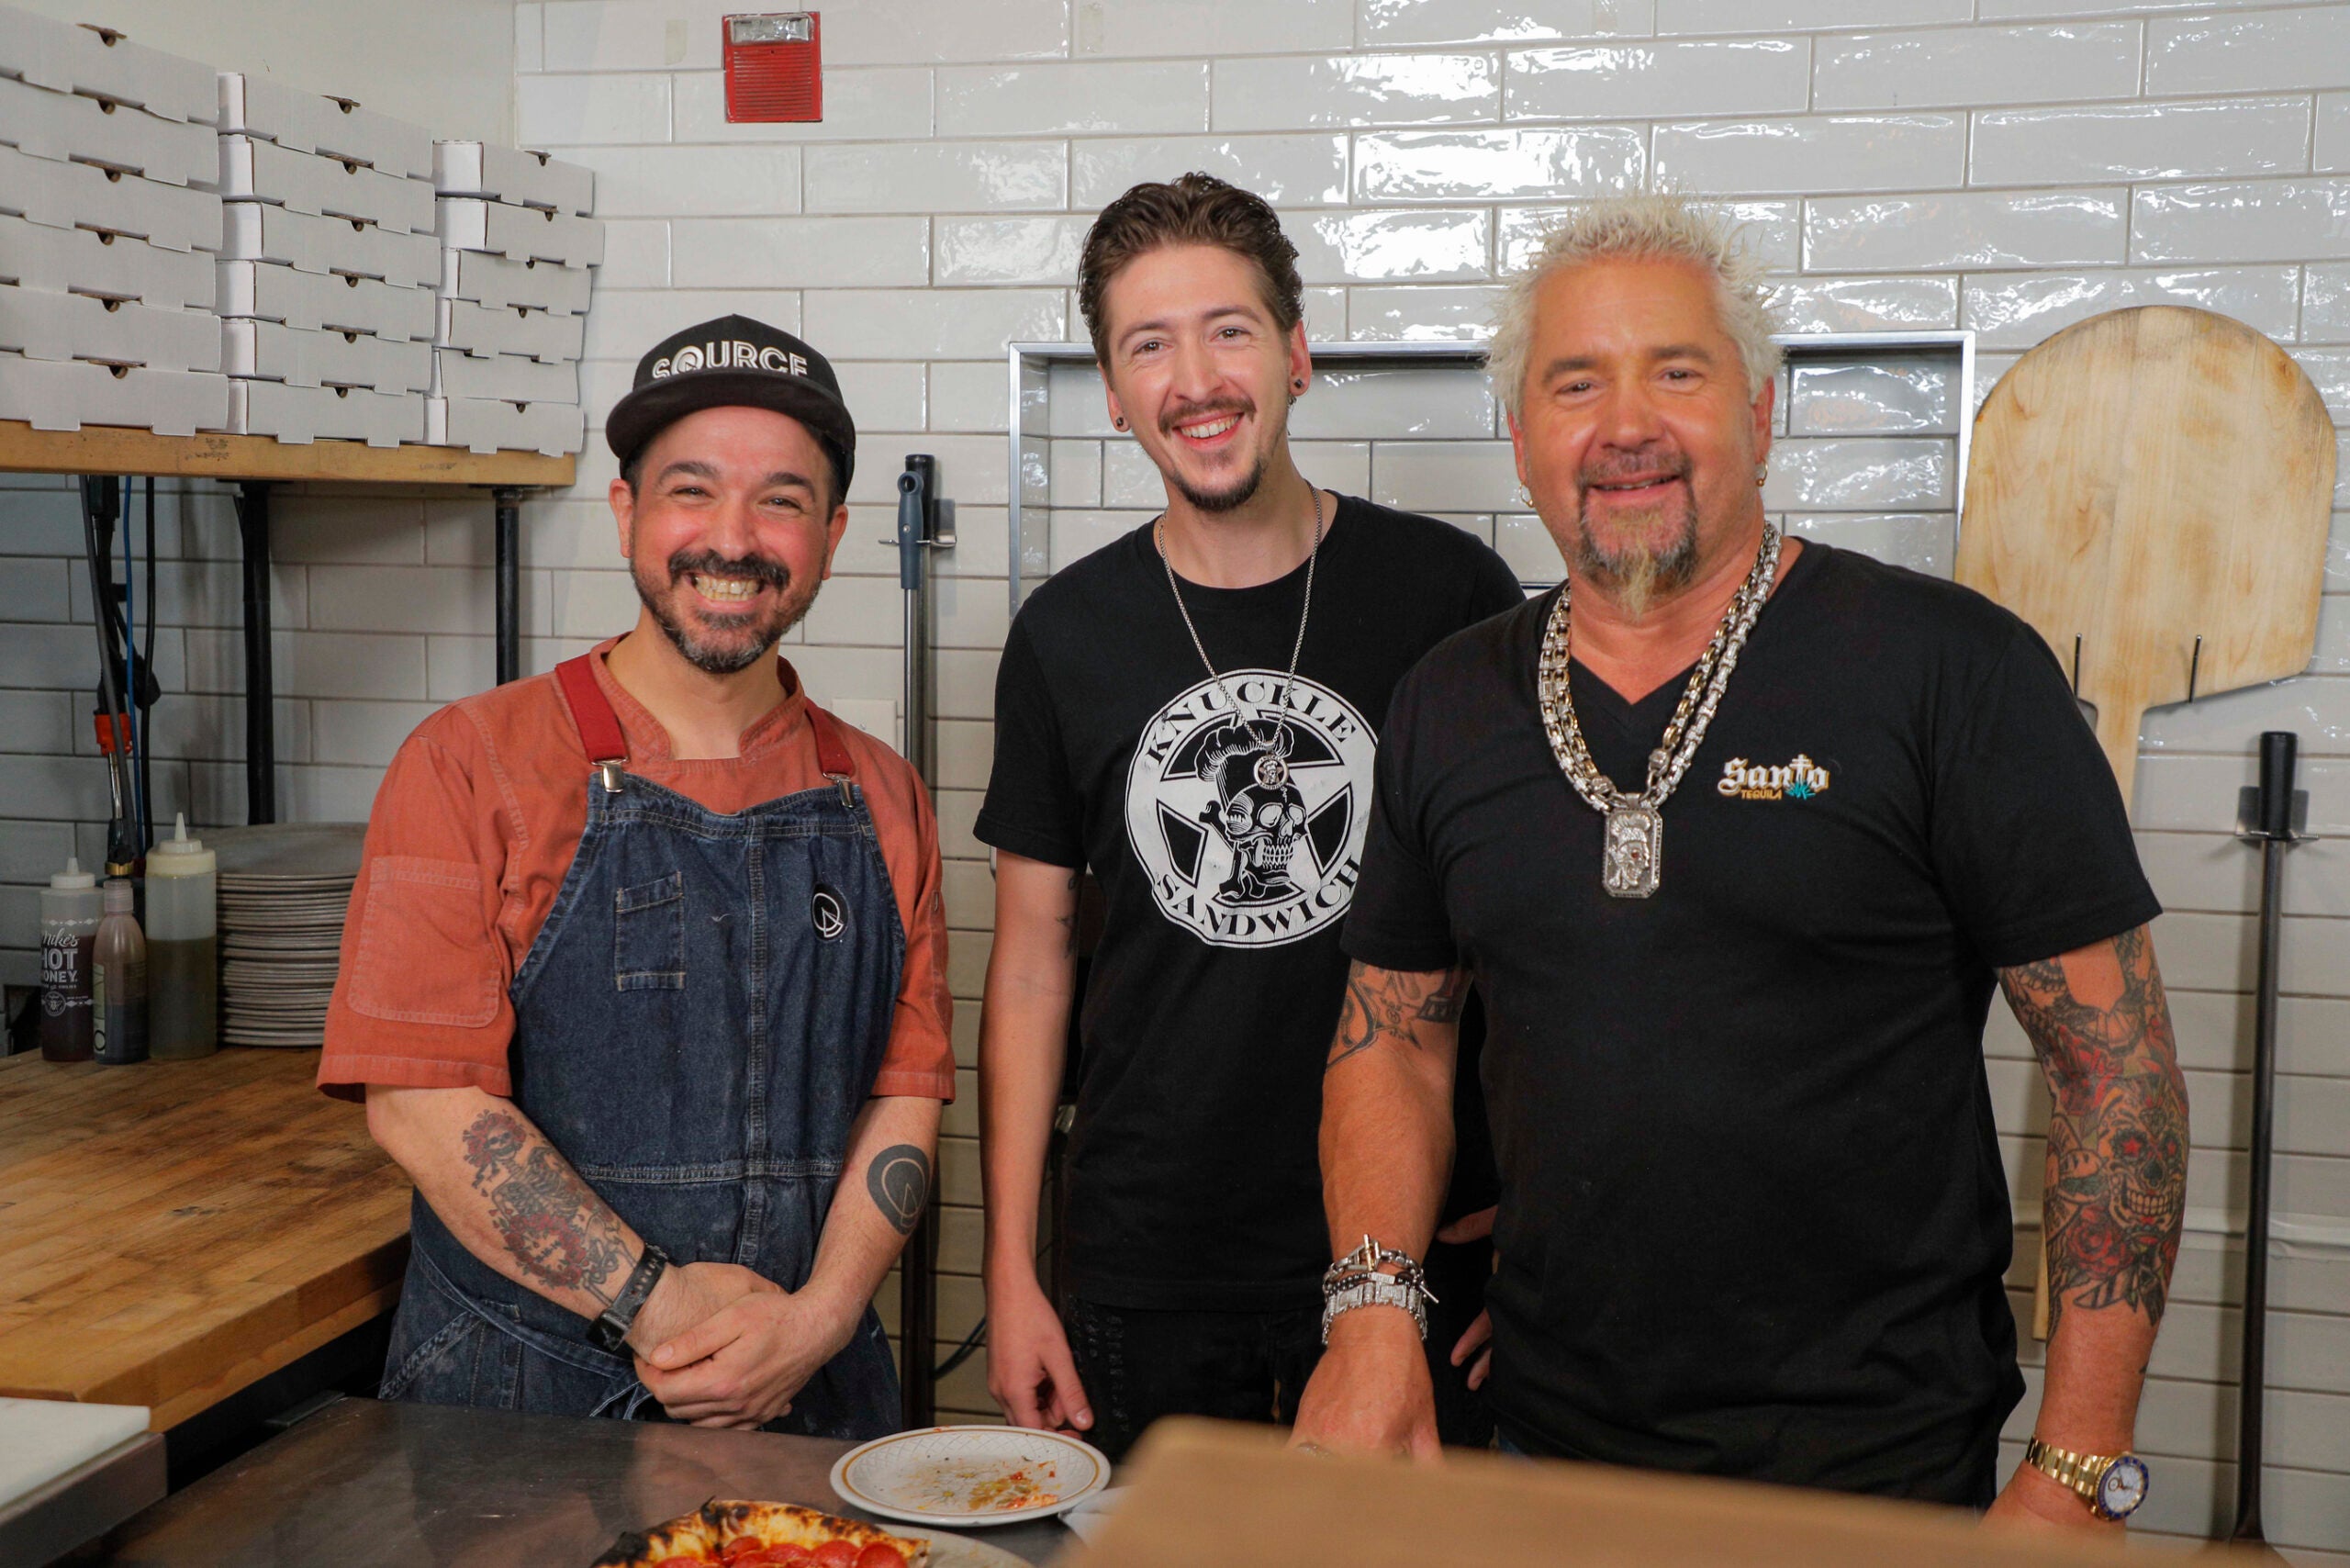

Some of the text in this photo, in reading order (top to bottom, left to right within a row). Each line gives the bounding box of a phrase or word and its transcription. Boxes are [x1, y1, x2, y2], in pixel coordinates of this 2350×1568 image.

[652, 341, 808, 380] SOURCE
[1146, 680, 1357, 765] KNUCKLE
[1717, 754, 1830, 797] Santo
[1740, 790, 1783, 801] TEQUILA
[1157, 854, 1360, 936] SANDWICH
